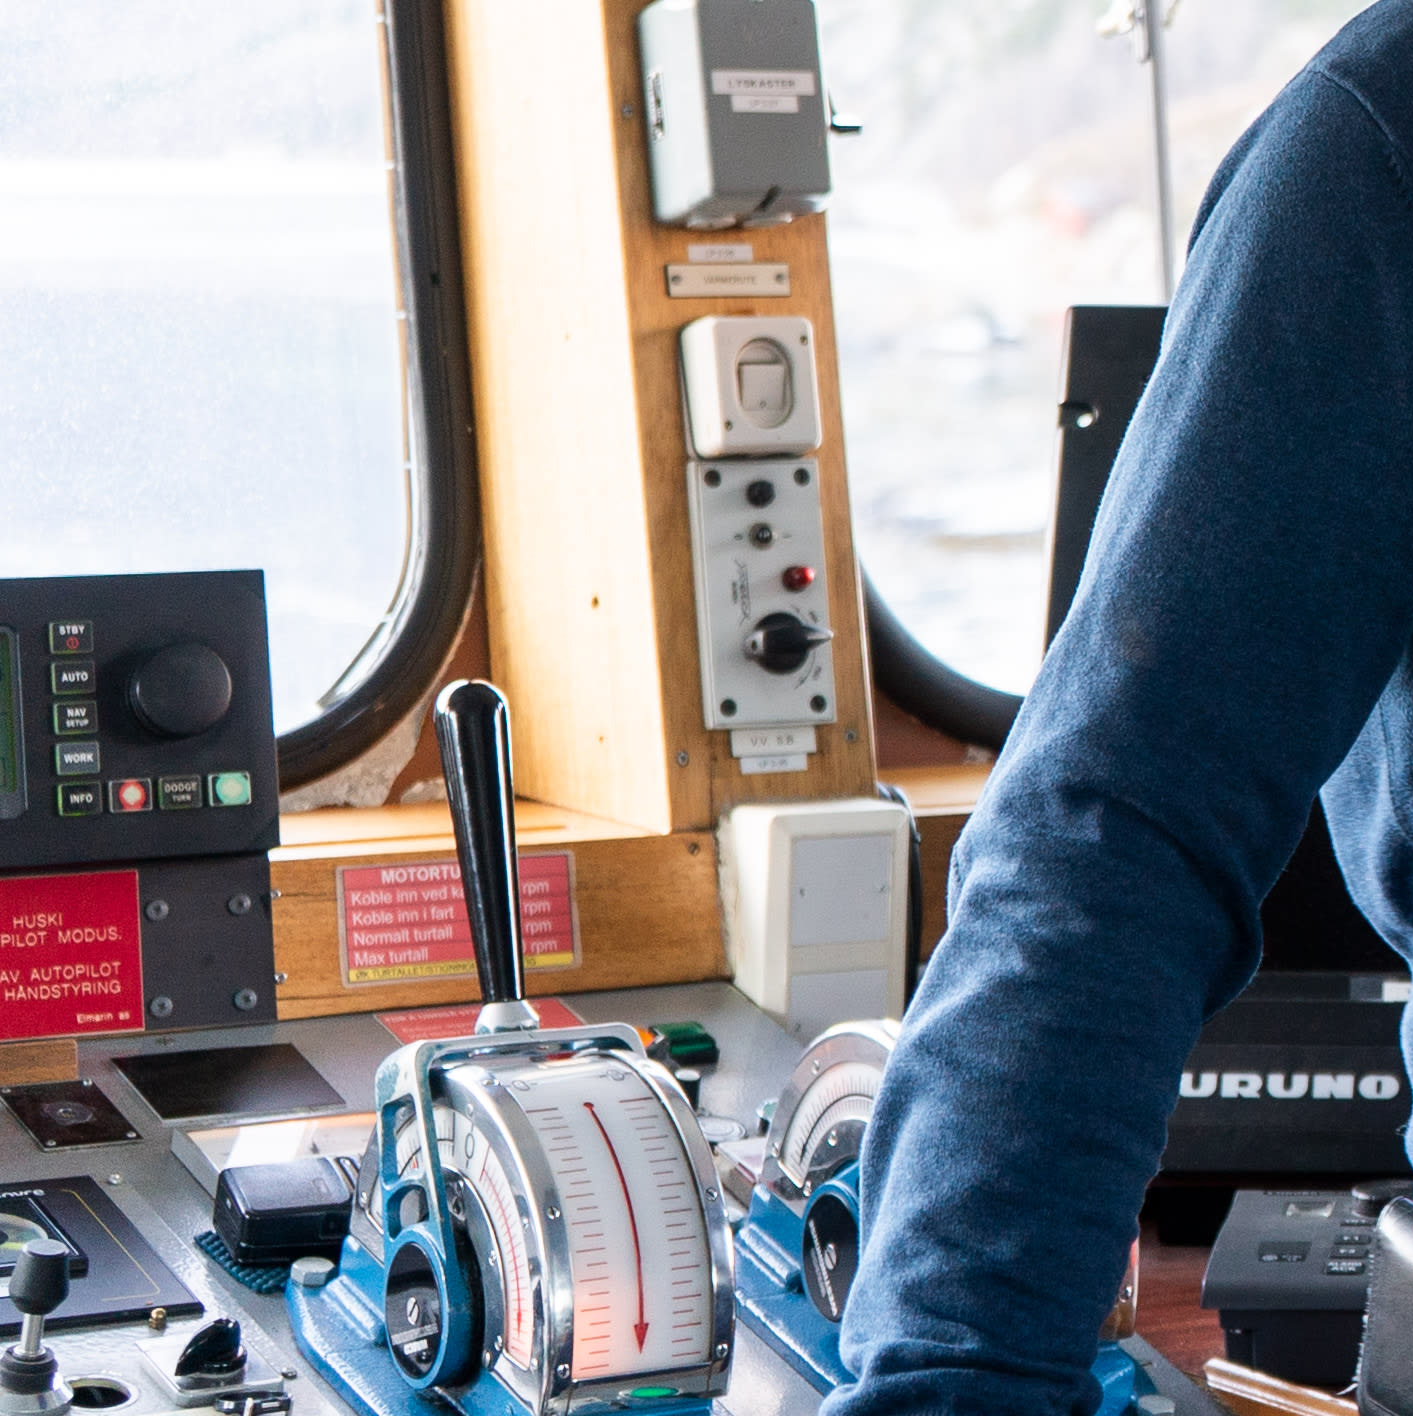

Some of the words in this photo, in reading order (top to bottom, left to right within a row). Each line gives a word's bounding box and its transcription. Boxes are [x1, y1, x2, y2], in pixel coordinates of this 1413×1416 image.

[727, 78, 797, 89] LYSKASTER
[59, 625, 85, 635] STBY
[61, 671, 89, 683] AUTO
[66, 708, 87, 718] NAV
[66, 719, 89, 728] SETUP
[63, 753, 95, 764] WORK
[163, 782, 198, 793] DODGE
[69, 793, 94, 804] INFO
[351, 890, 392, 906] Koble
[397, 888, 418, 903] inn
[422, 887, 448, 902] ved
[522, 881, 550, 896] rpm
[352, 910, 393, 926] Koble
[399, 909, 420, 924] inn
[430, 905, 454, 921] fart
[524, 900, 551, 915] rpm
[12, 913, 63, 930] HUSKI
[58, 926, 123, 944] MODUS.
[413, 925, 454, 942] turtall
[524, 919, 552, 935] rpm
[354, 949, 386, 966] Max
[389, 946, 429, 963] turtall
[530, 938, 558, 955] rpm
[30, 961, 121, 983] AUTOPILOT
[4, 979, 122, 1001] HÅNDSTYRING
